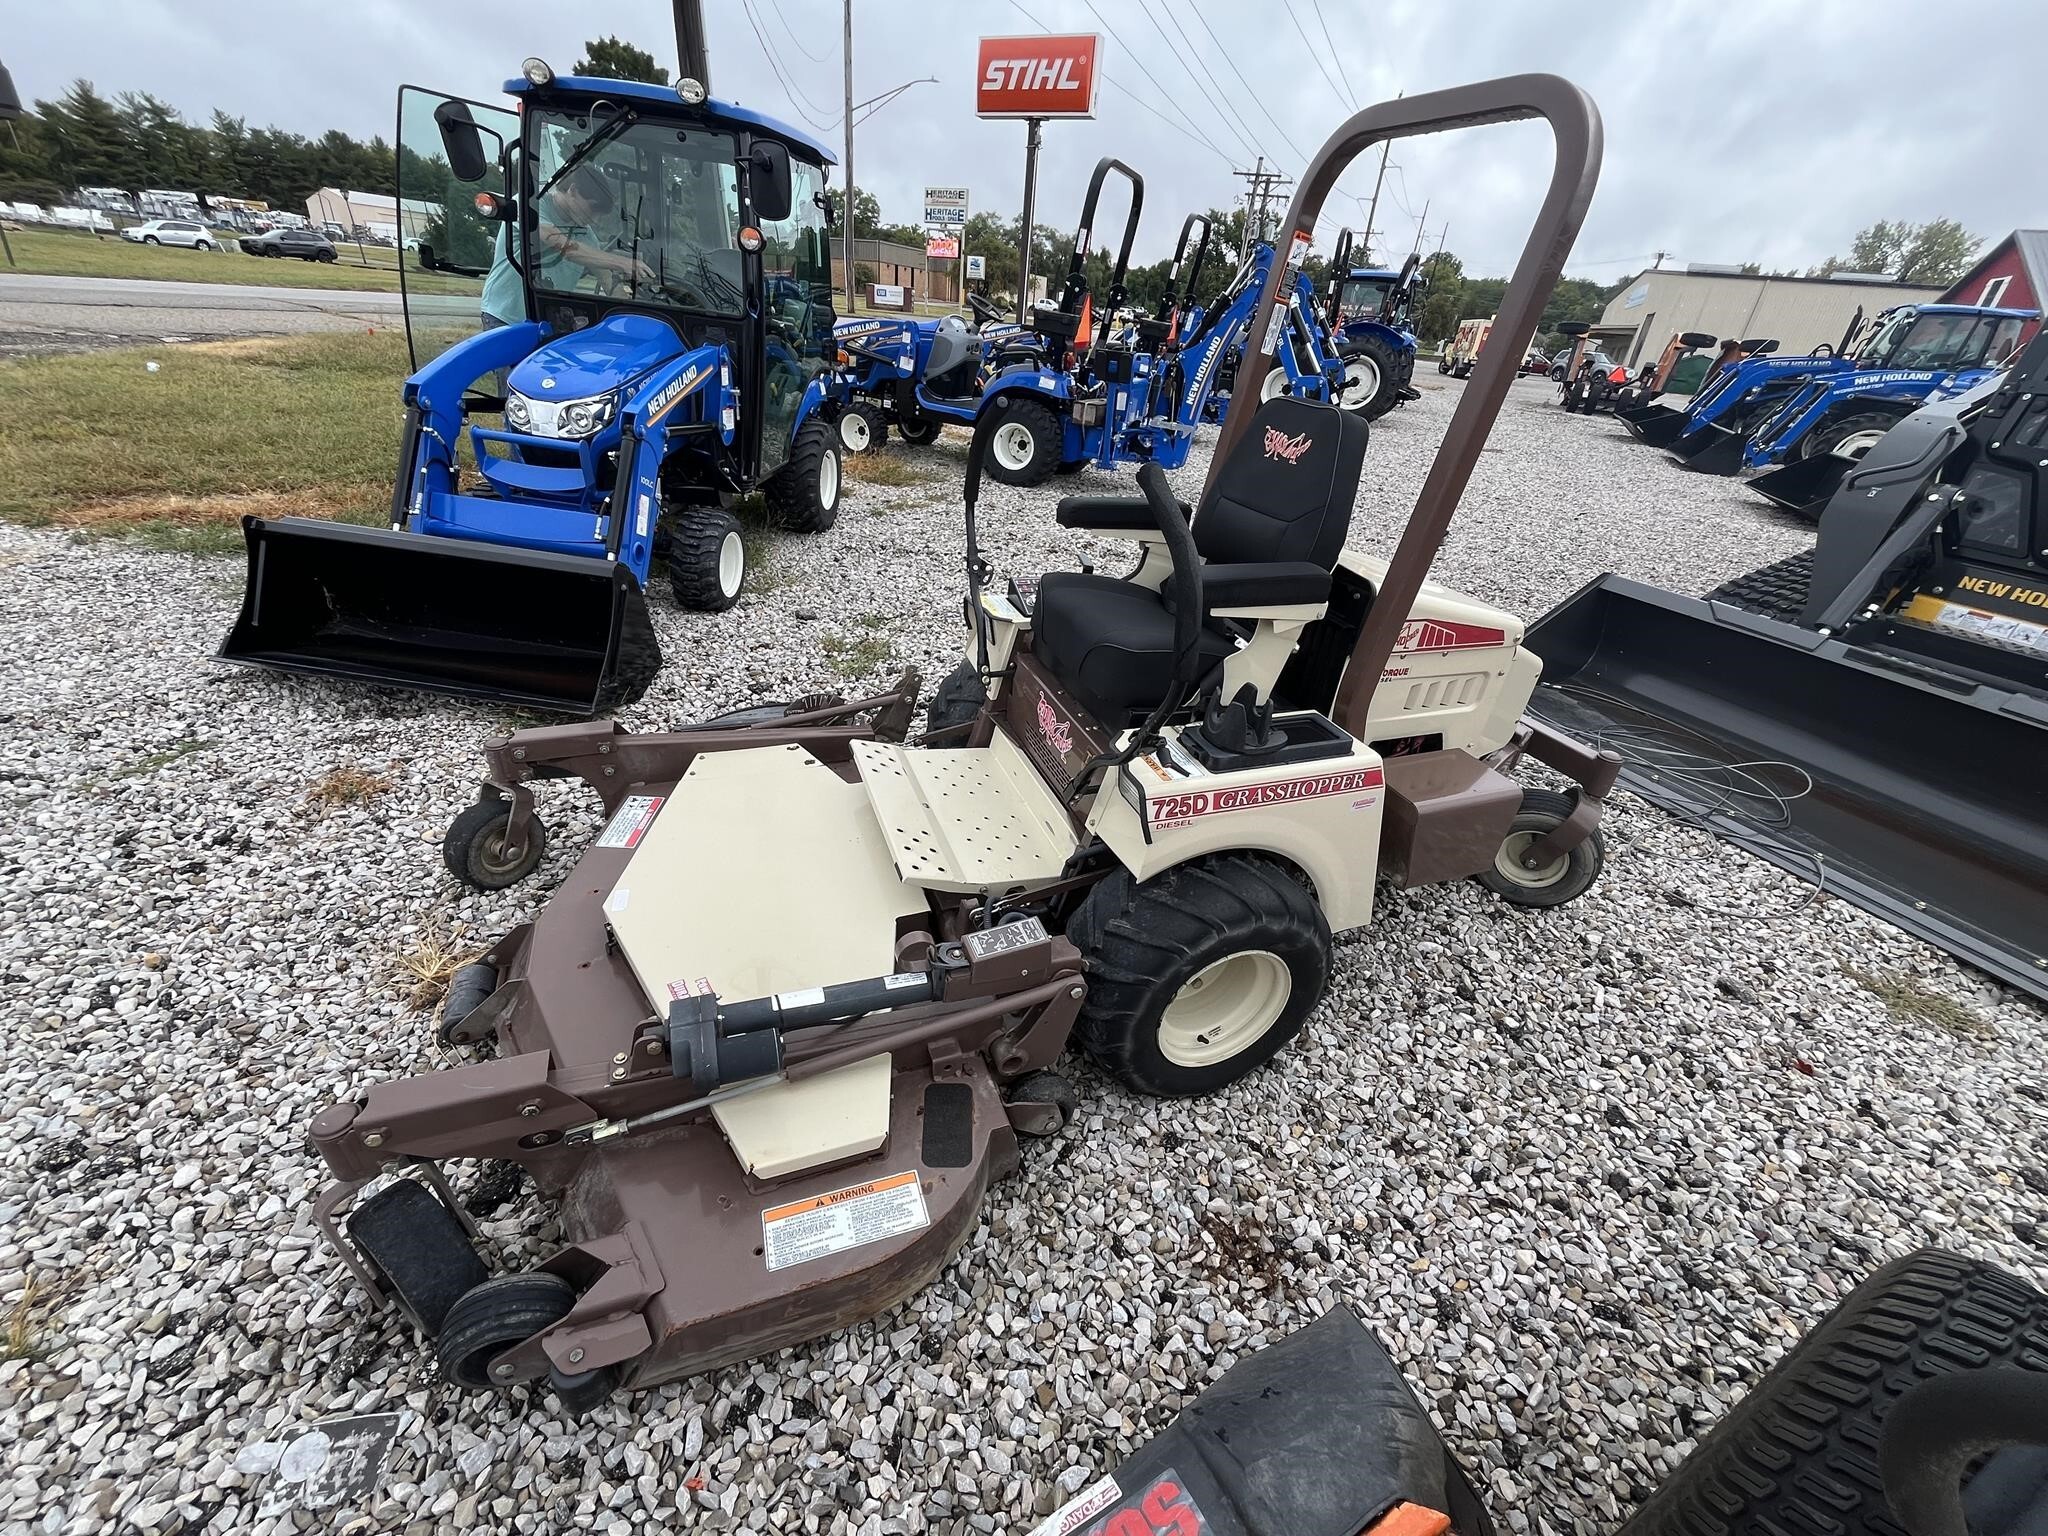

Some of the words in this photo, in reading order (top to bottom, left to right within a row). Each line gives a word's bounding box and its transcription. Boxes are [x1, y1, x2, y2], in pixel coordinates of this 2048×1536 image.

[981, 58, 1080, 90] STIHL
[926, 190, 965, 199] HERITAGE
[926, 208, 964, 221] HERITAGE
[833, 327, 849, 337] NEW
[849, 321, 881, 333] HOLLAND
[997, 326, 1021, 336] HOLLAND
[1186, 381, 1200, 405] NEW
[1195, 336, 1221, 381] HOLLAND
[1769, 360, 1789, 368] NEW
[1790, 360, 1832, 368] HOLLAND
[1855, 375, 1881, 386] NEW
[1882, 372, 1933, 382] HOLLAND
[648, 391, 667, 416] NEW
[666, 365, 698, 400] HOLLAND
[1833, 383, 1885, 395] WORKMASTER
[1958, 576, 2011, 597] NEW
[1382, 667, 1409, 677] ORQUE
[1152, 793, 1209, 820] 725D
[1219, 772, 1366, 809] GRASSHOPPER
[1156, 819, 1193, 831] DIESEL
[829, 1185, 875, 1203] WARNING
[1058, 1499, 1096, 1532] DANG
